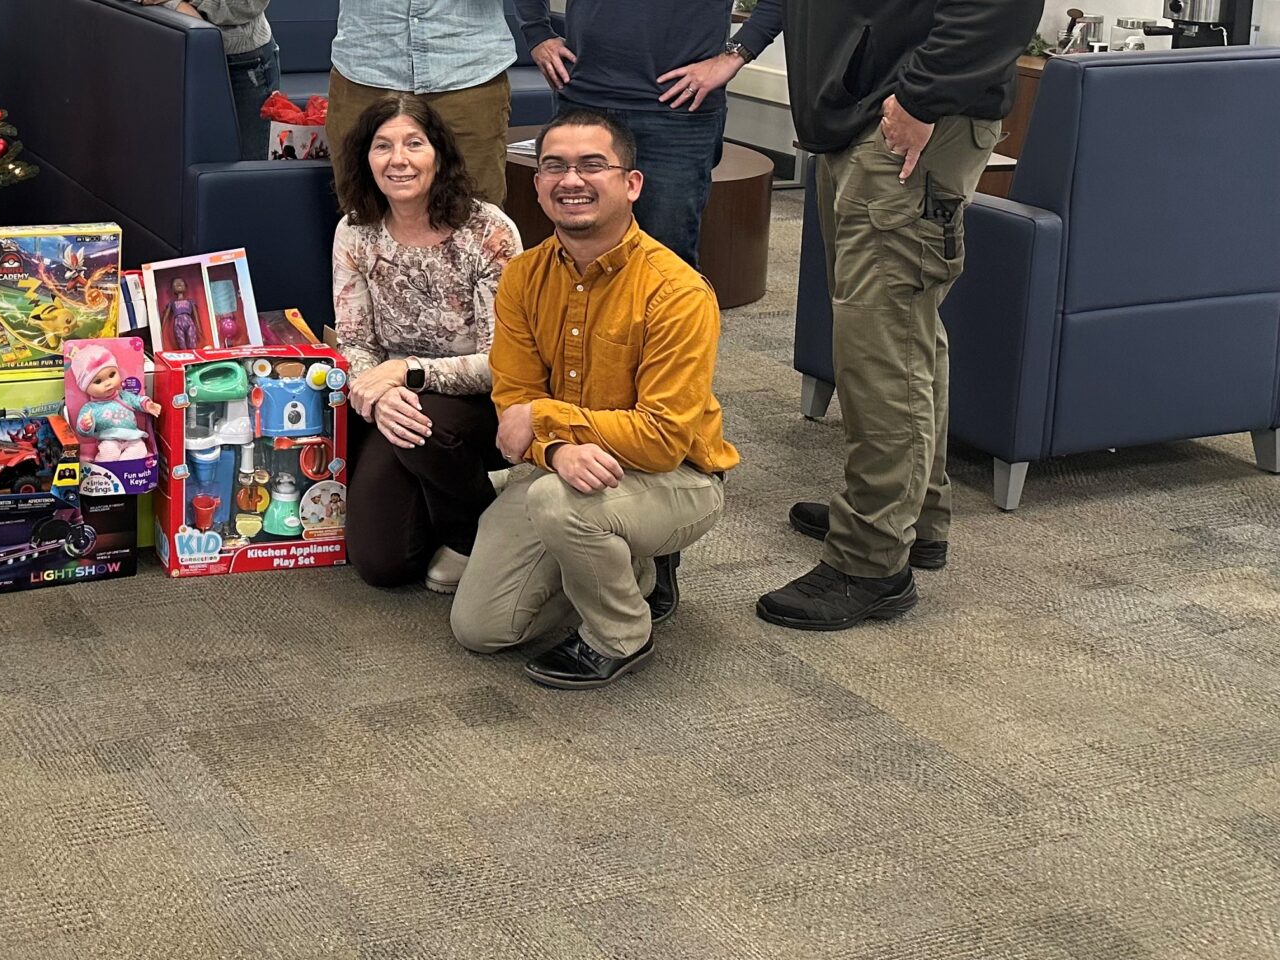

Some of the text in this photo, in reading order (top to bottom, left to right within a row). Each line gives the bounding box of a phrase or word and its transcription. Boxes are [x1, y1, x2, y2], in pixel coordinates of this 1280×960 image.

[330, 373, 343, 381] 26
[138, 469, 151, 478] with
[177, 534, 221, 554] KID
[247, 544, 341, 558] Kitchen Appliance
[273, 555, 315, 568] Play Set
[30, 562, 121, 583] LIGHTSHOW
